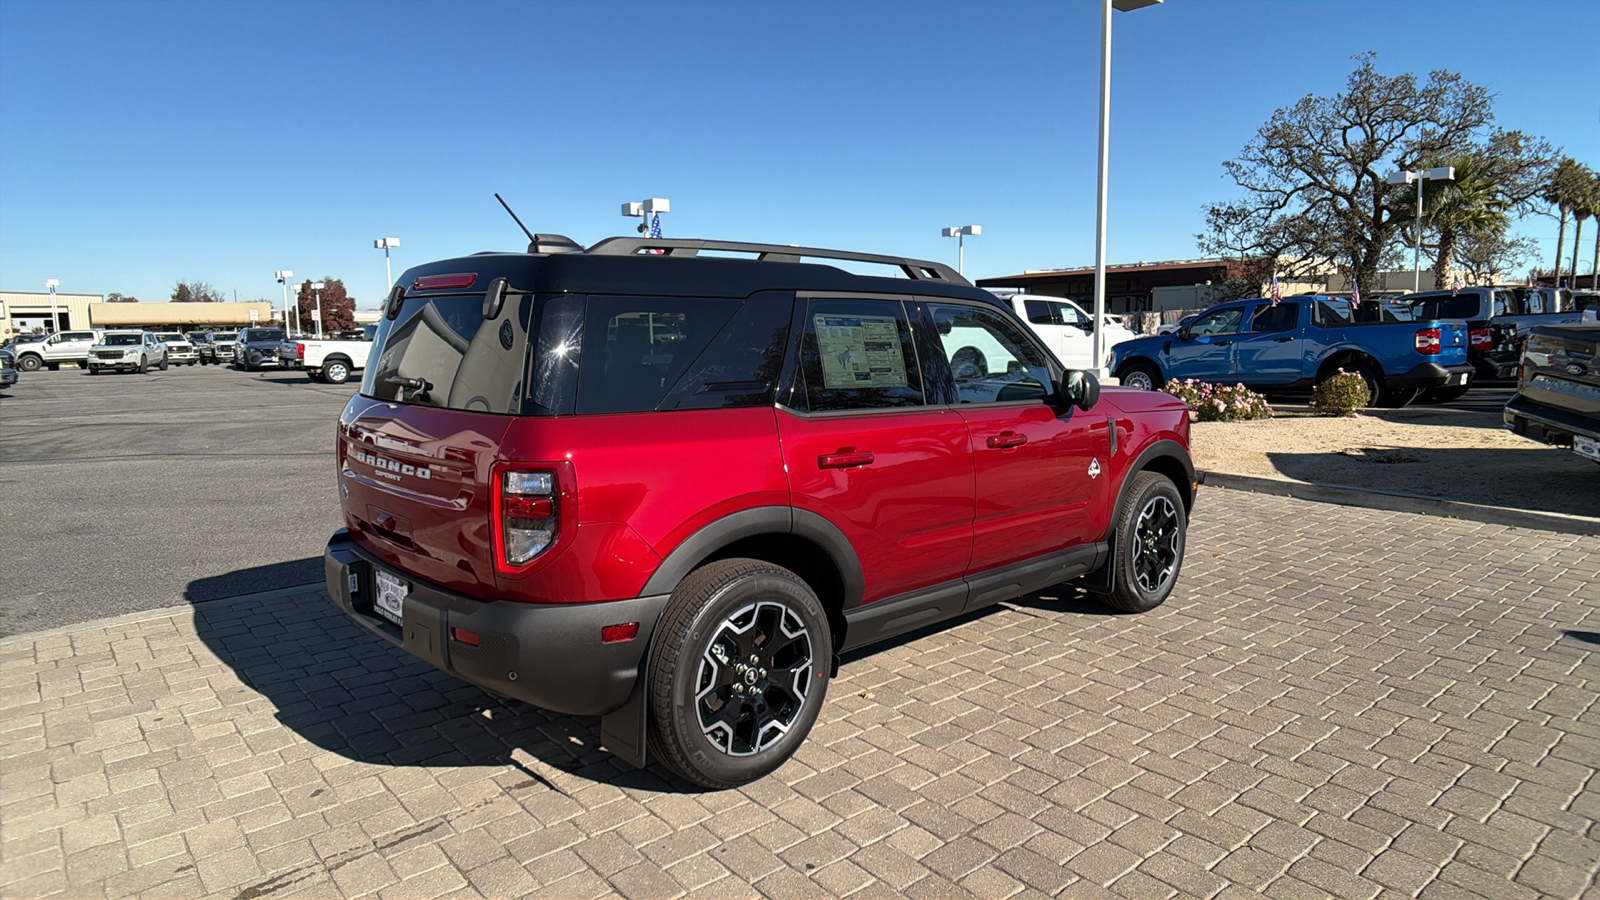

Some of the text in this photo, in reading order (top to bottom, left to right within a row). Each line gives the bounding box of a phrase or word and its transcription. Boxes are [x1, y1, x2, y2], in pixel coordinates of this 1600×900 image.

[357, 451, 431, 480] BRONCO
[374, 469, 402, 482] SPORT
[781, 582, 817, 614] MICHELIN
